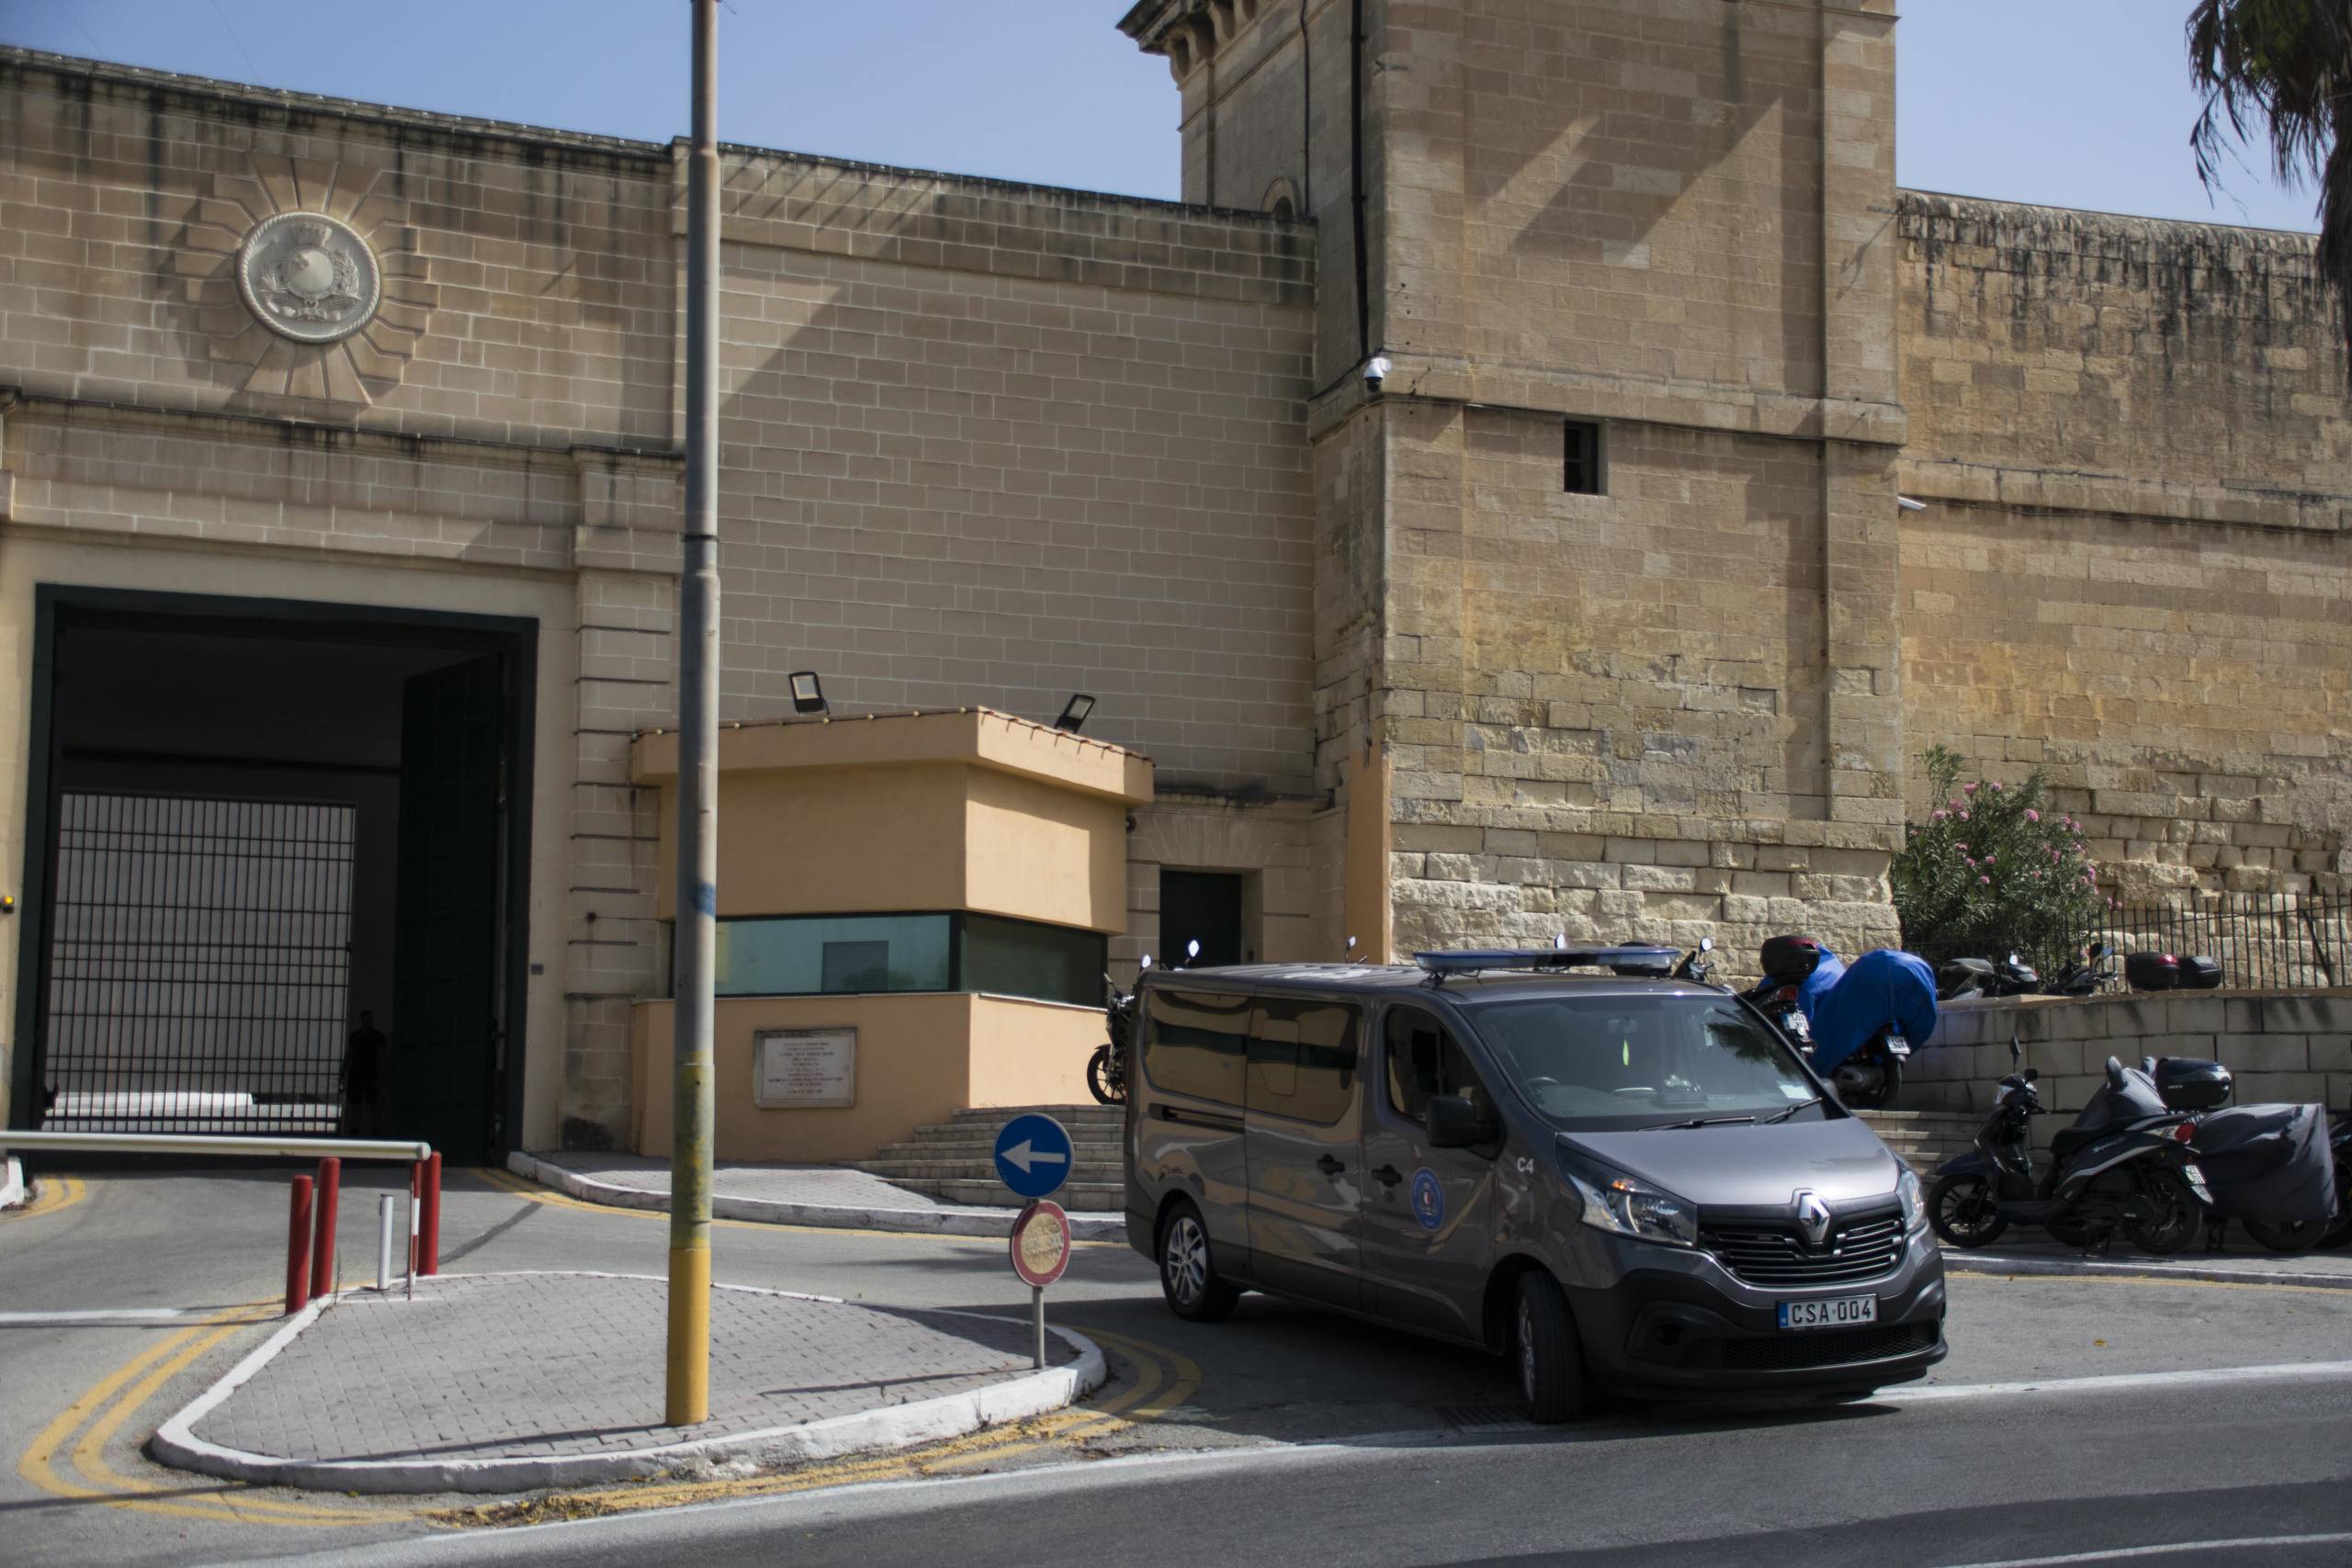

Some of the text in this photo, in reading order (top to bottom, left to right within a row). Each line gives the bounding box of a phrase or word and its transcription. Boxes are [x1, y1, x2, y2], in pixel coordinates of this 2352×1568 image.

[1518, 1157, 1534, 1174] C4
[1792, 1300, 1871, 1324] CSA 004
